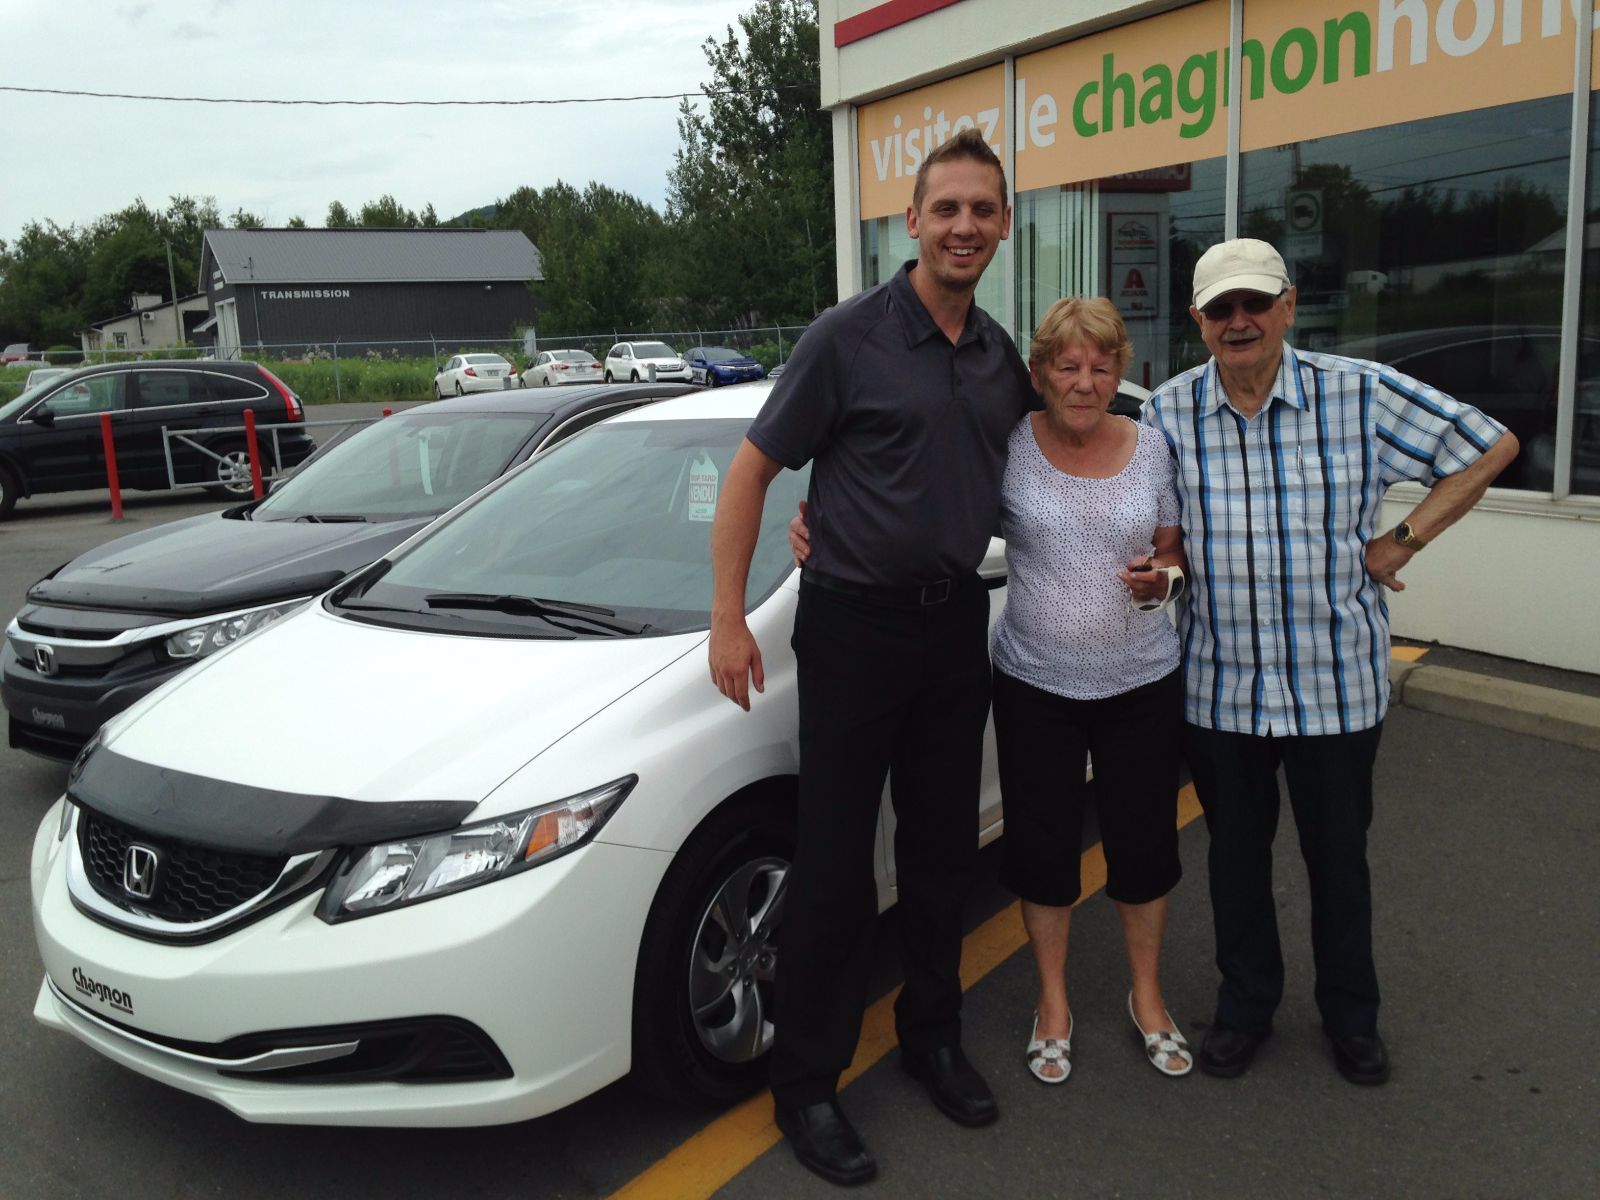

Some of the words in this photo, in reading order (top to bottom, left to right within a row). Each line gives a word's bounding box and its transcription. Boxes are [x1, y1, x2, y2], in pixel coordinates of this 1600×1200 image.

[1015, 77, 1058, 152] le
[261, 289, 350, 299] TRANSMISSION
[690, 485, 714, 502] VENDU
[72, 967, 133, 1010] Chagnon
